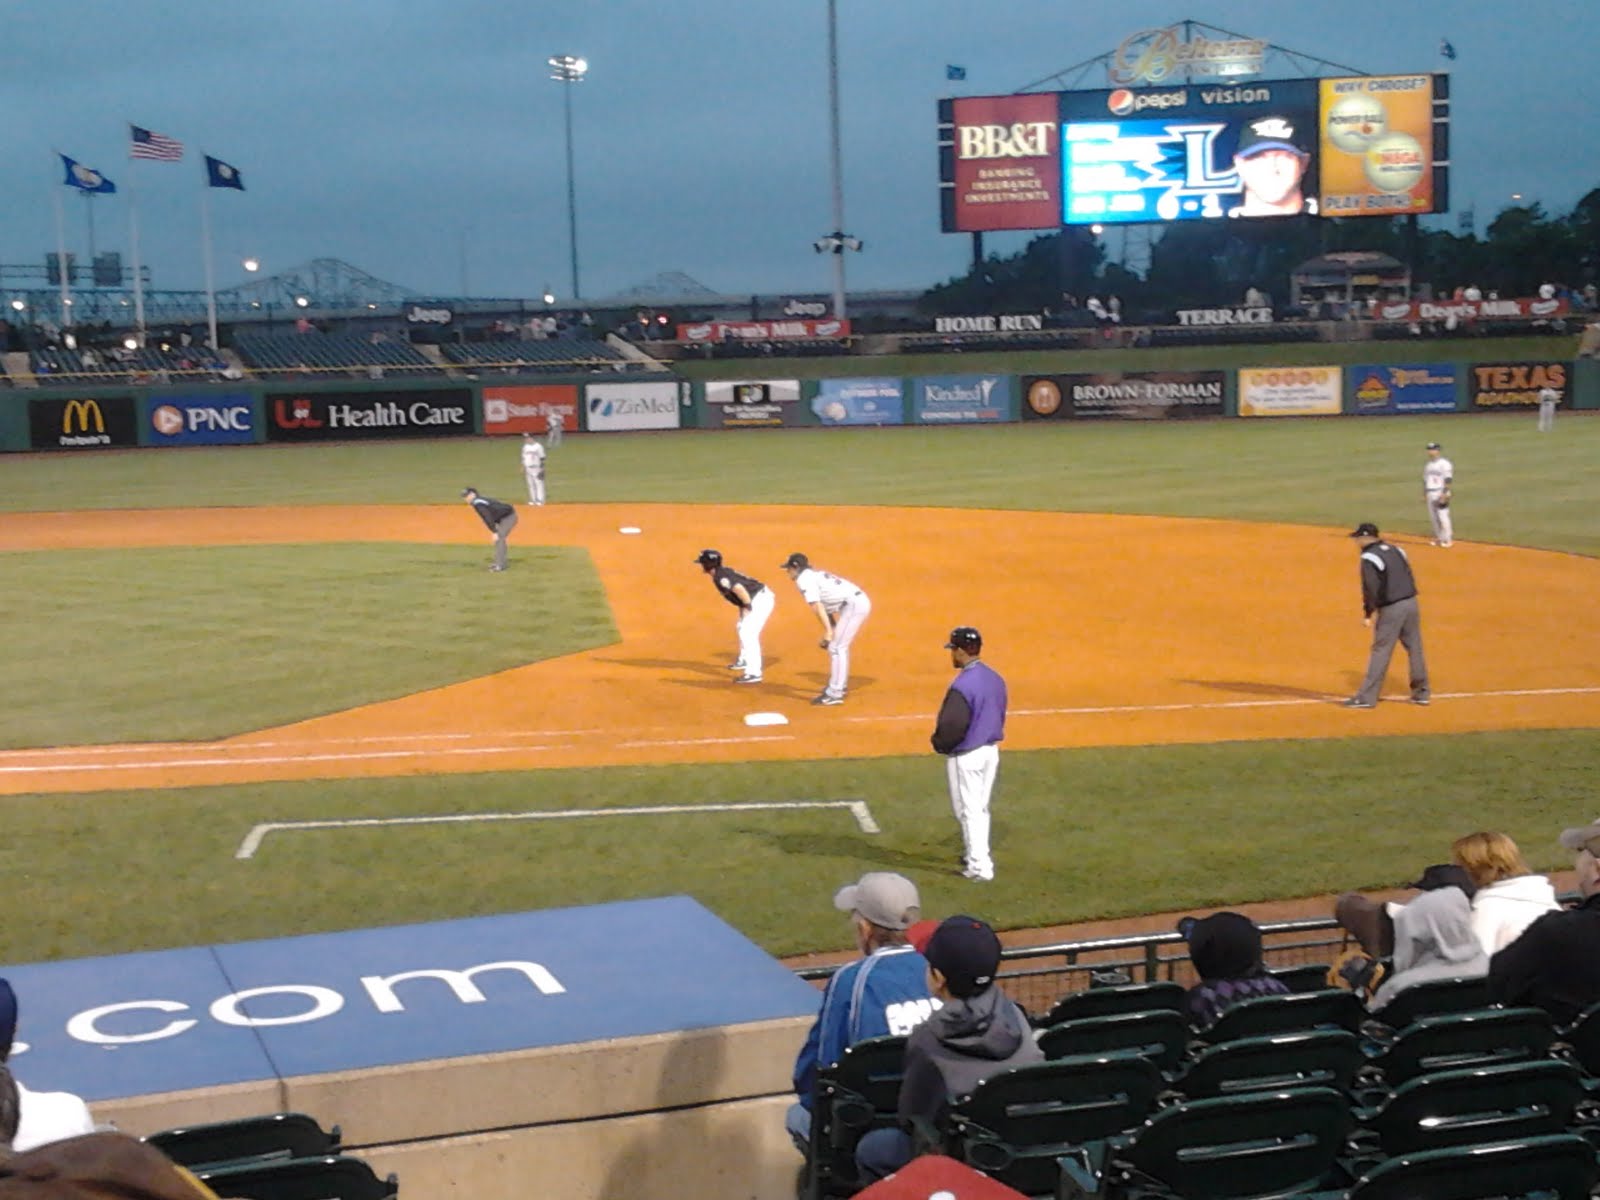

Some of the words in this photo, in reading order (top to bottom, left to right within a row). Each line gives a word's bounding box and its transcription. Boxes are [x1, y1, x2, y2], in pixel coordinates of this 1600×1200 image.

[1135, 90, 1187, 110] pepsi
[1201, 87, 1270, 104] vision
[958, 121, 1056, 159] BB&T
[407, 306, 452, 325] Jeep
[935, 316, 997, 333] HOME
[999, 314, 1042, 331] RUN
[1176, 307, 1274, 325] TERRACE
[1474, 364, 1567, 390] TEXAS
[186, 406, 250, 431] PNC
[328, 402, 407, 428] Health
[409, 402, 465, 424] Care
